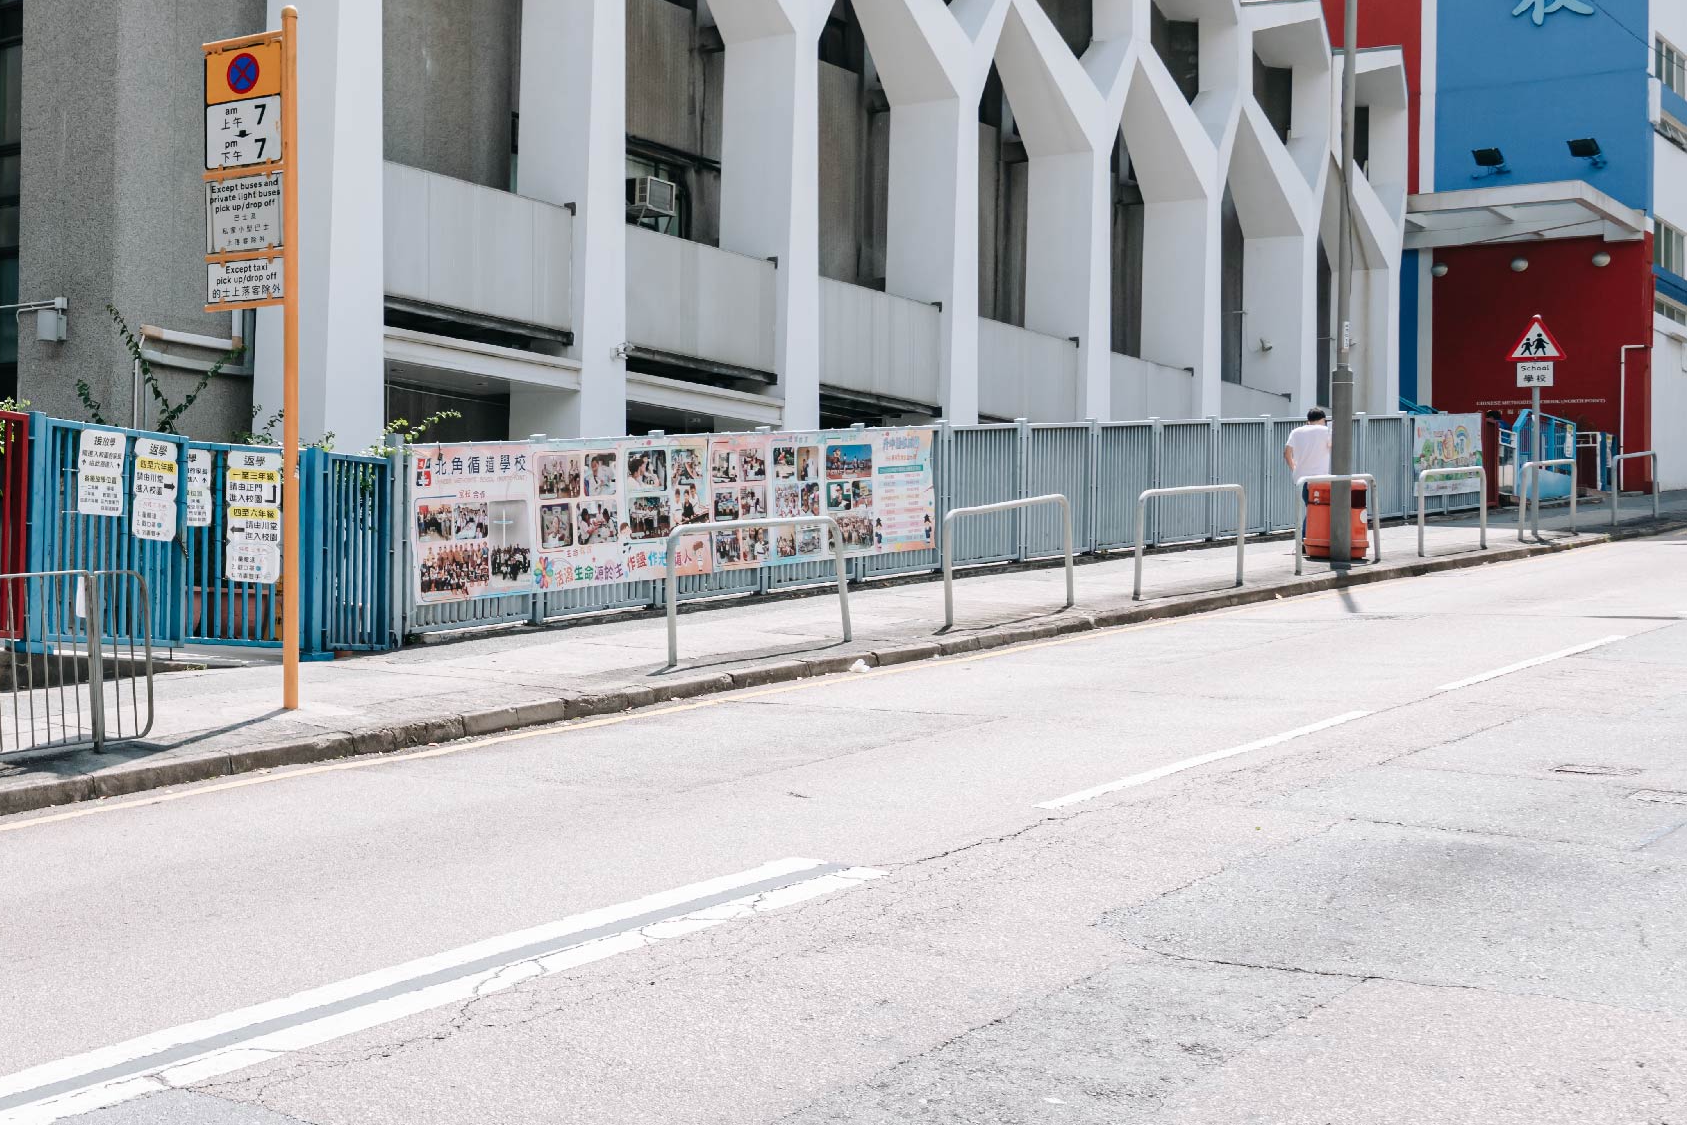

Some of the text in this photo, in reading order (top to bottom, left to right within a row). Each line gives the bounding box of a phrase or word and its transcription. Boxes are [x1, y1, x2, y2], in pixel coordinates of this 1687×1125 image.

[225, 103, 267, 125] am 7
[221, 117, 243, 130] 上午
[225, 137, 267, 159] pm 7
[221, 150, 243, 163] 下午
[211, 177, 279, 194] Except buses and
[209, 189, 281, 205] private light buses
[215, 198, 276, 214] pick up/drop off
[225, 262, 268, 274] Except taxi
[216, 271, 277, 286] pick up/drop off
[212, 283, 281, 298] 的士上落客除外
[1523, 374, 1547, 383] 學校
[149, 443, 168, 457] 返學
[140, 459, 174, 473] 四至六年級
[243, 455, 266, 467] 返學
[435, 454, 526, 475] 北角循道學校
[232, 471, 275, 482] 一至三年級
[136, 484, 163, 496] 進入校園
[229, 481, 263, 492] 請由正門
[229, 493, 263, 504] 進入校園
[233, 508, 275, 518] 四至六年級
[245, 520, 278, 531] 請由川堂
[245, 532, 278, 542] 進入校園
